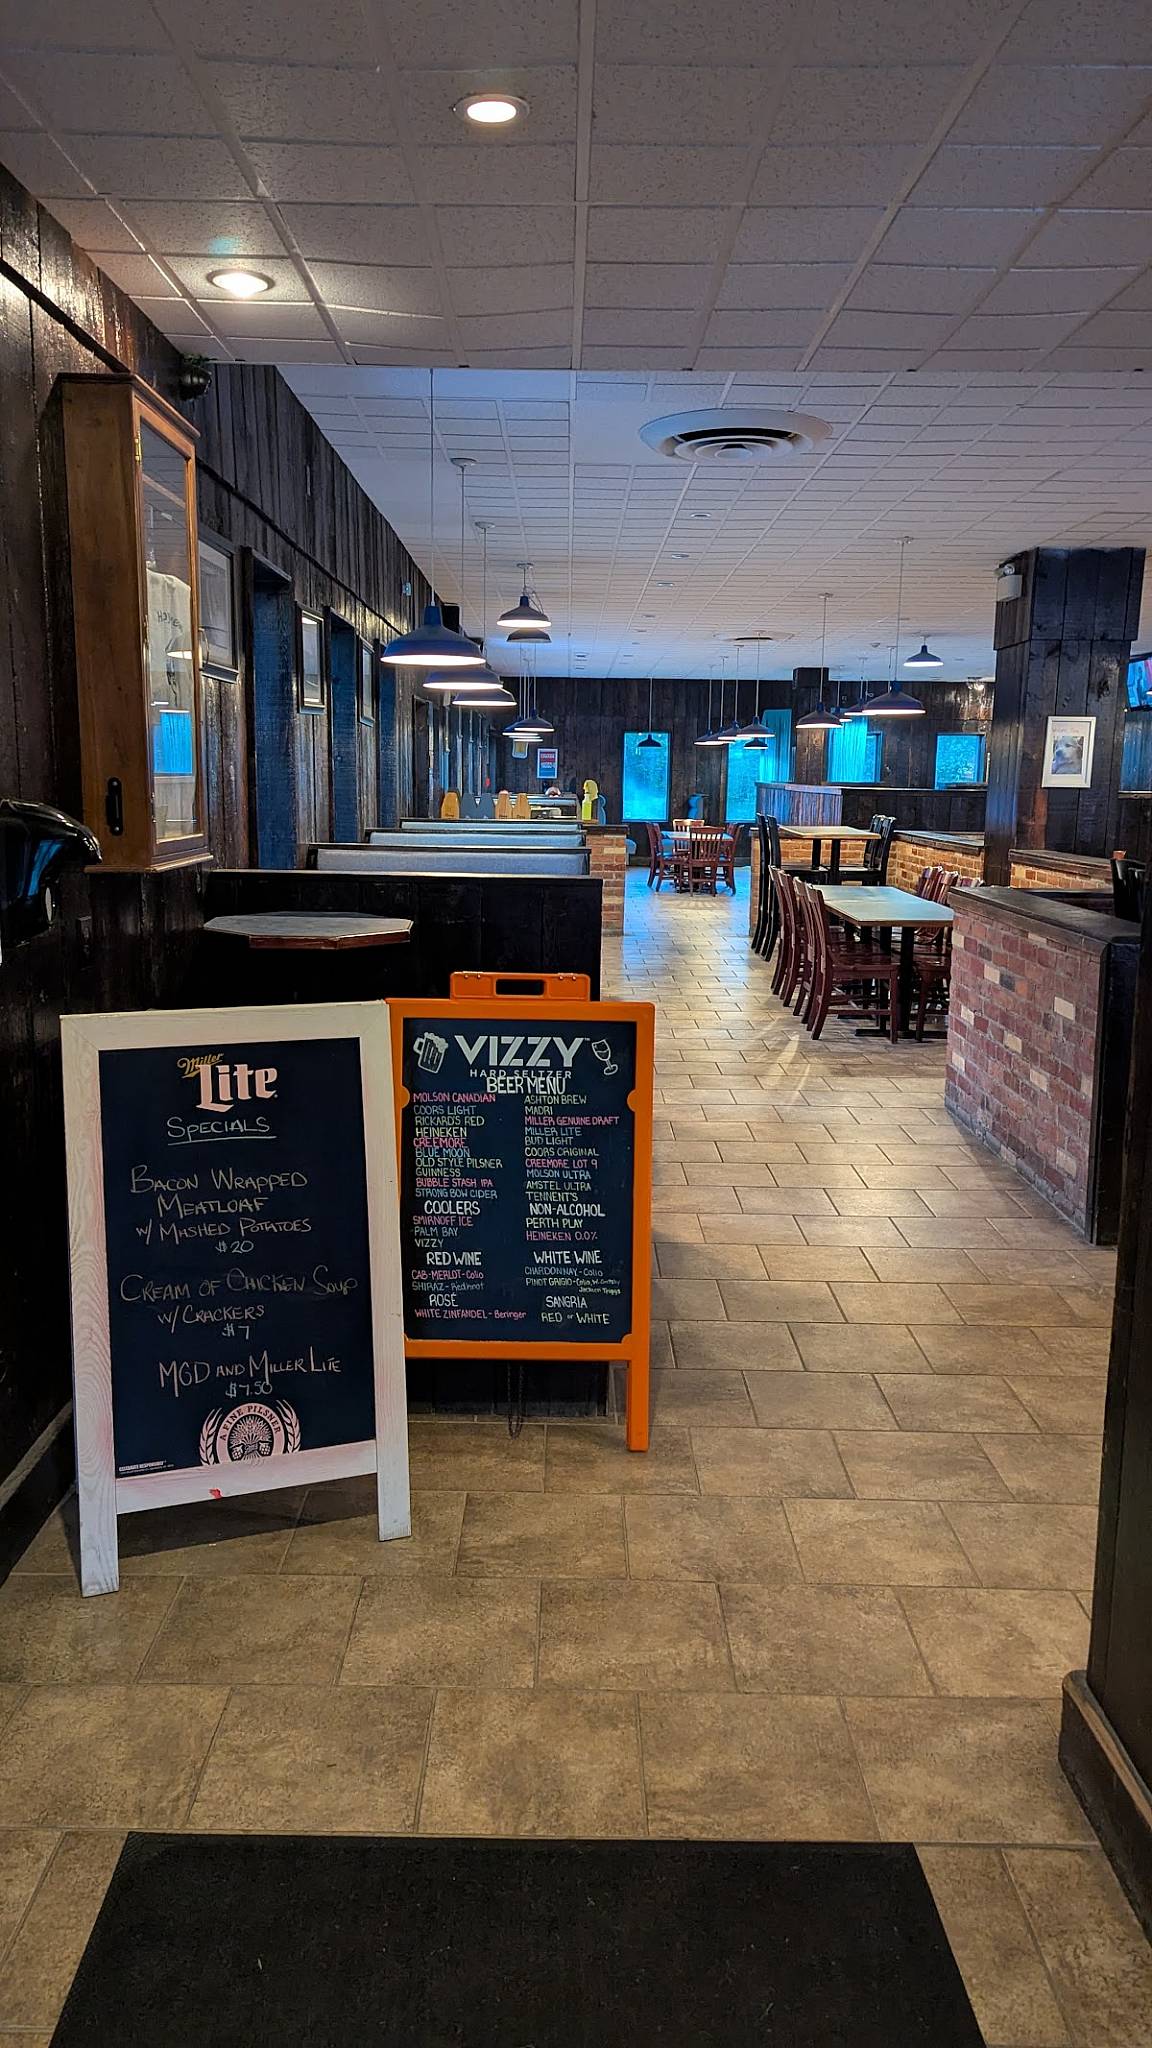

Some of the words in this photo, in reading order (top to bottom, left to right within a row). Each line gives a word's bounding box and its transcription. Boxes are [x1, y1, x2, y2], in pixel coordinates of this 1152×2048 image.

[455, 1035, 584, 1067] VIZZY
[177, 1053, 224, 1079] Miller
[470, 1069, 506, 1078] HARD
[514, 1070, 571, 1079] SELTZER
[195, 1064, 278, 1113] Lite
[486, 1077, 523, 1094] BEER
[527, 1078, 565, 1094] MENU
[413, 1093, 450, 1103] MOLSON
[452, 1093, 496, 1103] CANADIAN
[524, 1095, 560, 1104] ASHTON
[561, 1095, 587, 1104] BREW
[414, 1105, 444, 1115] COORS
[447, 1105, 477, 1115] LIGHT
[525, 1105, 553, 1115] MADRI
[415, 1116, 461, 1126] RICKARD'S
[465, 1117, 484, 1126] RED
[525, 1116, 555, 1125] MILLER
[557, 1117, 591, 1125] GENUINE
[592, 1116, 620, 1125] DRAFT
[416, 1127, 467, 1138] HEINEKEN
[525, 1127, 558, 1136] MILLER
[561, 1127, 582, 1136] LITE
[413, 1138, 467, 1148] CREEMORE
[525, 1137, 544, 1145] BUD
[546, 1137, 574, 1145] LIGHT
[415, 1148, 439, 1157] BLUE
[443, 1148, 471, 1157] MOON
[525, 1148, 555, 1156] COORS
[416, 1158, 434, 1167] OLD
[437, 1158, 464, 1167] STYLE
[467, 1159, 502, 1168] PILSNER
[525, 1159, 569, 1168] CREEMORE
[573, 1159, 588, 1168] LOT
[591, 1159, 598, 1169] 9
[416, 1168, 461, 1177] GUINNESS
[527, 1169, 560, 1179] MOLSON
[562, 1169, 591, 1180] ULTRA
[416, 1178, 449, 1187] BUBBLE
[452, 1178, 477, 1187] STASH
[481, 1179, 493, 1187] IPA
[527, 1180, 561, 1190] AMSTEL
[564, 1181, 591, 1191] ULTRA
[470, 1189, 497, 1199] CIDER
[424, 1200, 480, 1215] COOLERS
[530, 1203, 605, 1217] NON-ALCOHOL
[413, 1216, 456, 1225] SMIRNOFF
[459, 1216, 473, 1226] ICE
[526, 1218, 559, 1228] PERTH
[562, 1219, 583, 1228] PLAY
[414, 1227, 438, 1236] PALM
[442, 1227, 458, 1236] BAY
[526, 1231, 571, 1241] HEINEKEN
[575, 1231, 597, 1241] 0.0%
[216, 1240, 255, 1254] $20
[414, 1239, 444, 1248] VIZZY
[427, 1252, 451, 1265] RED
[453, 1253, 481, 1265] WINE
[534, 1251, 571, 1264] WHITE
[575, 1250, 602, 1264] WINE
[526, 1278, 547, 1286] PINOT
[545, 1296, 587, 1309] SANGRIA
[414, 1309, 442, 1319] WHITE
[542, 1313, 562, 1323] RED
[576, 1312, 610, 1324] WHITE
[159, 1360, 210, 1397] MGD
[225, 1382, 273, 1397] $7.50
[223, 1409, 243, 1430] FINE
[247, 1405, 281, 1433] PILSNER
